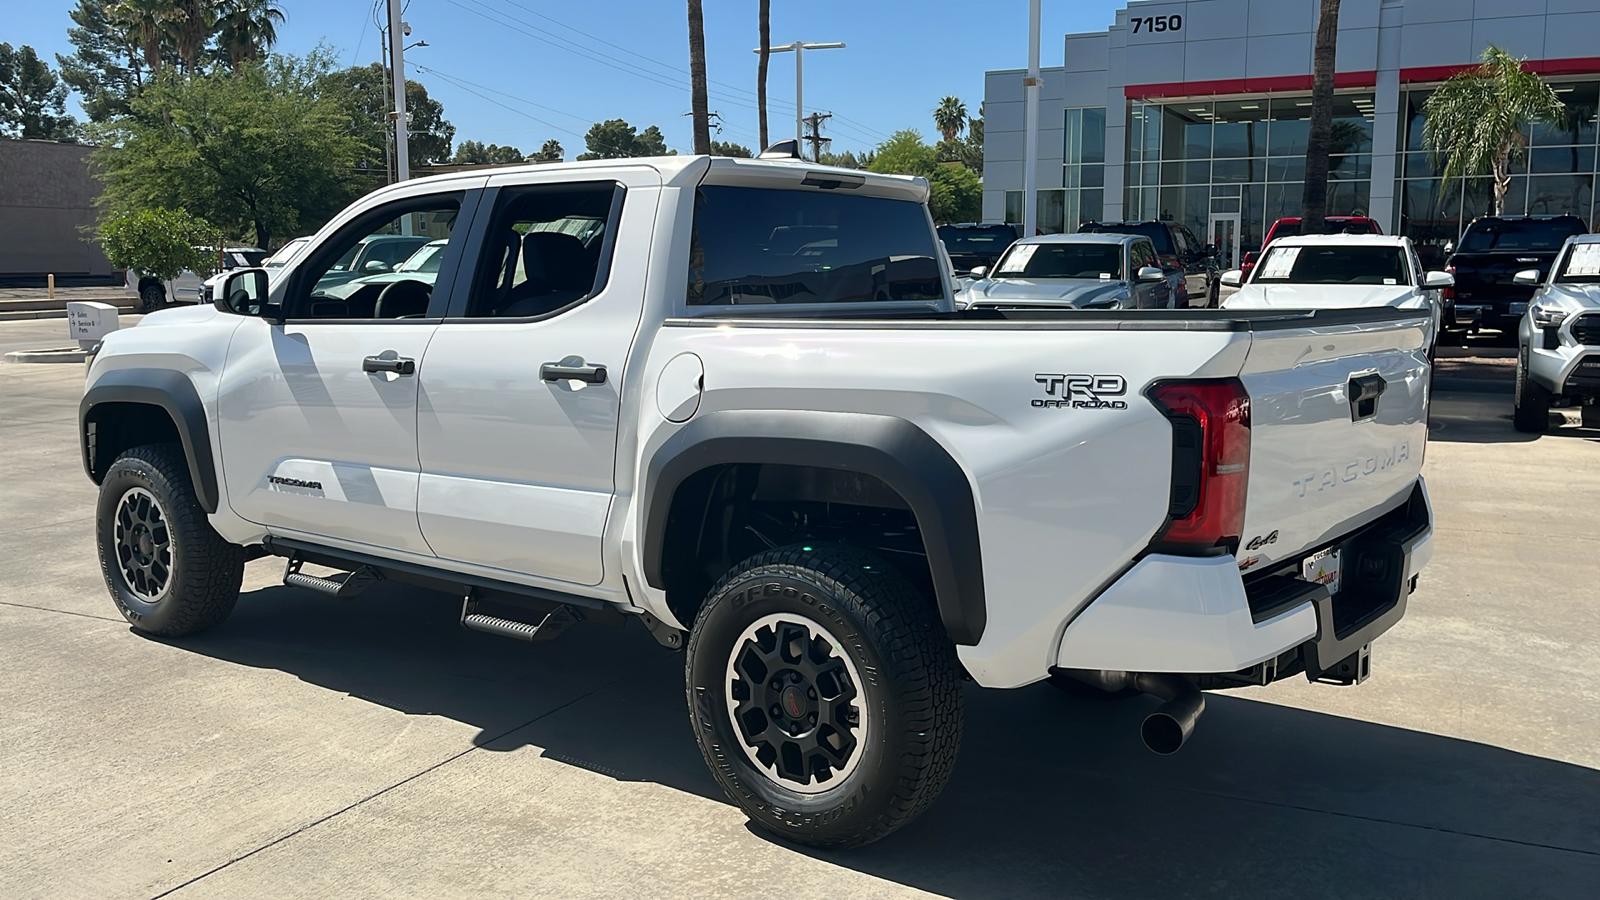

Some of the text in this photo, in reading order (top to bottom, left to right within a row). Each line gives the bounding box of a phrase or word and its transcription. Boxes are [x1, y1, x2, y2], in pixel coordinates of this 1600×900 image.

[1130, 15, 1182, 34] 7150
[1034, 373, 1128, 402] TRD
[1031, 399, 1128, 410] OFF ROAD
[1292, 441, 1410, 498] TACOMA
[267, 474, 322, 490] TACOMA
